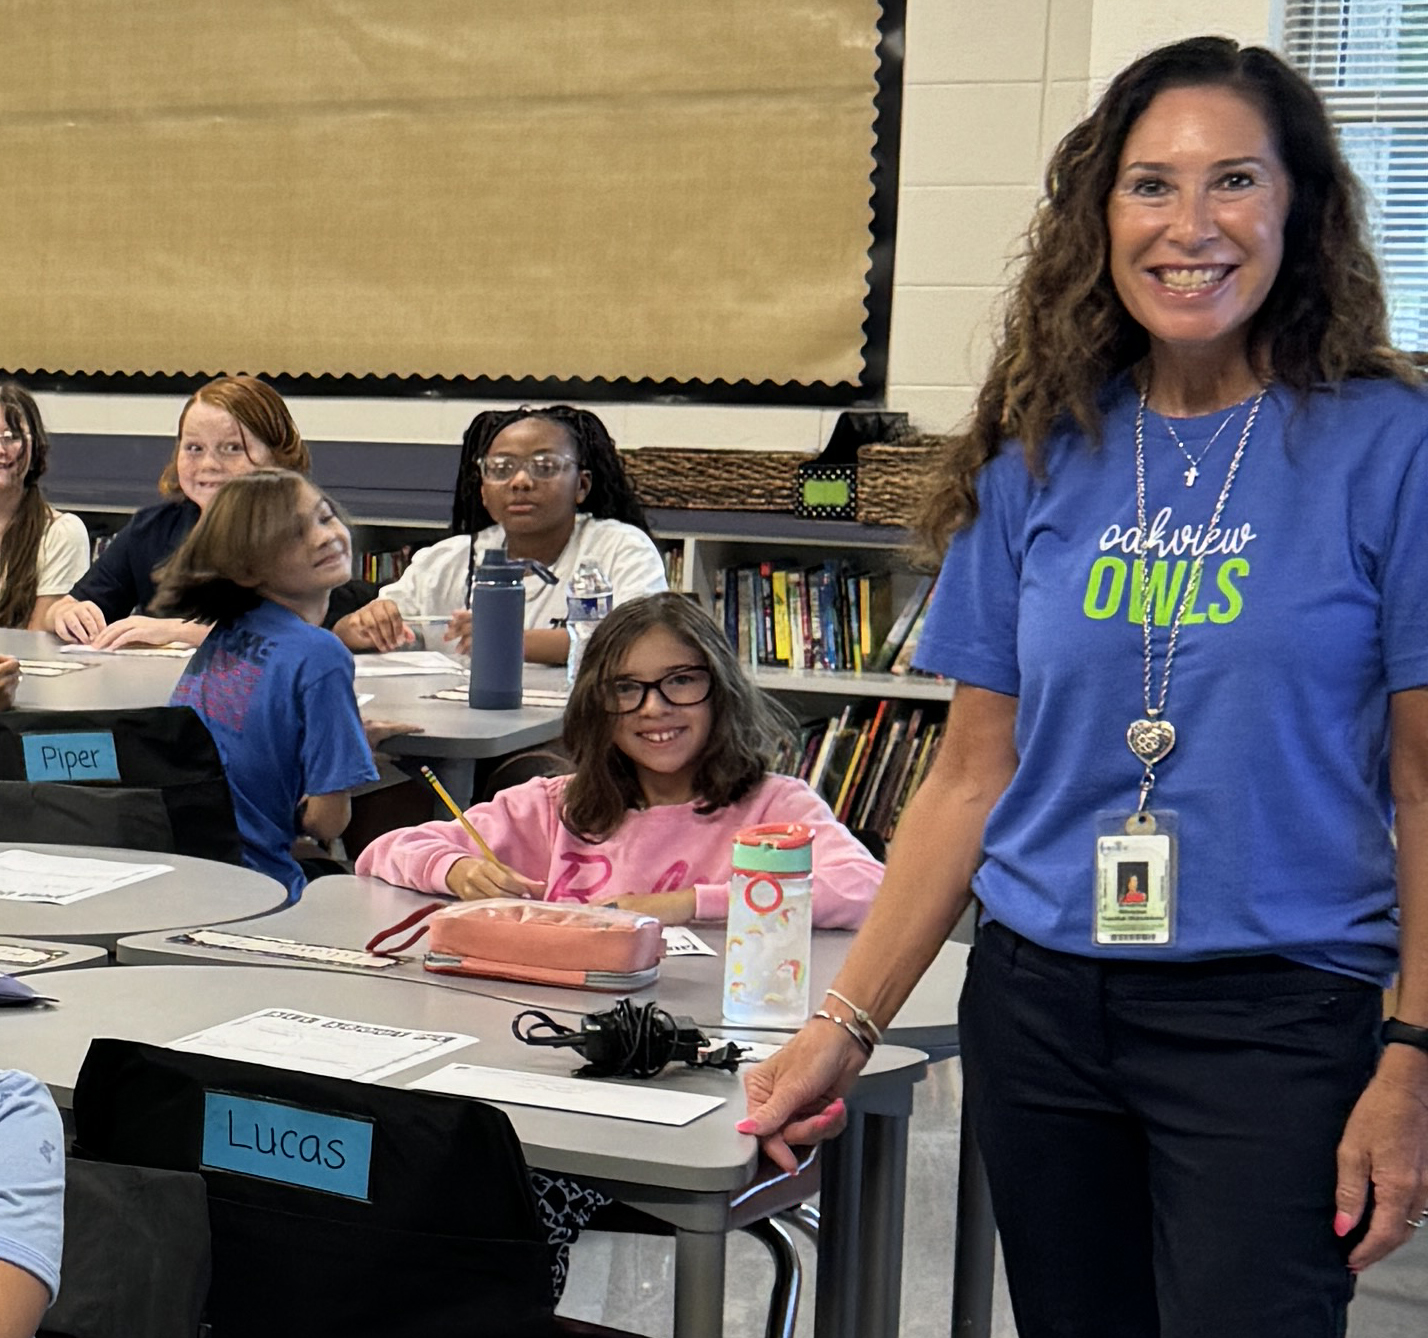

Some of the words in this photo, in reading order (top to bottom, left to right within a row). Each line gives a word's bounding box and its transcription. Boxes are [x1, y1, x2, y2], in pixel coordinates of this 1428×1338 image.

[1099, 507, 1257, 558] oakview
[1083, 556, 1251, 627] OWLS
[41, 746, 100, 780] Piper
[228, 1109, 346, 1170] Lucas
